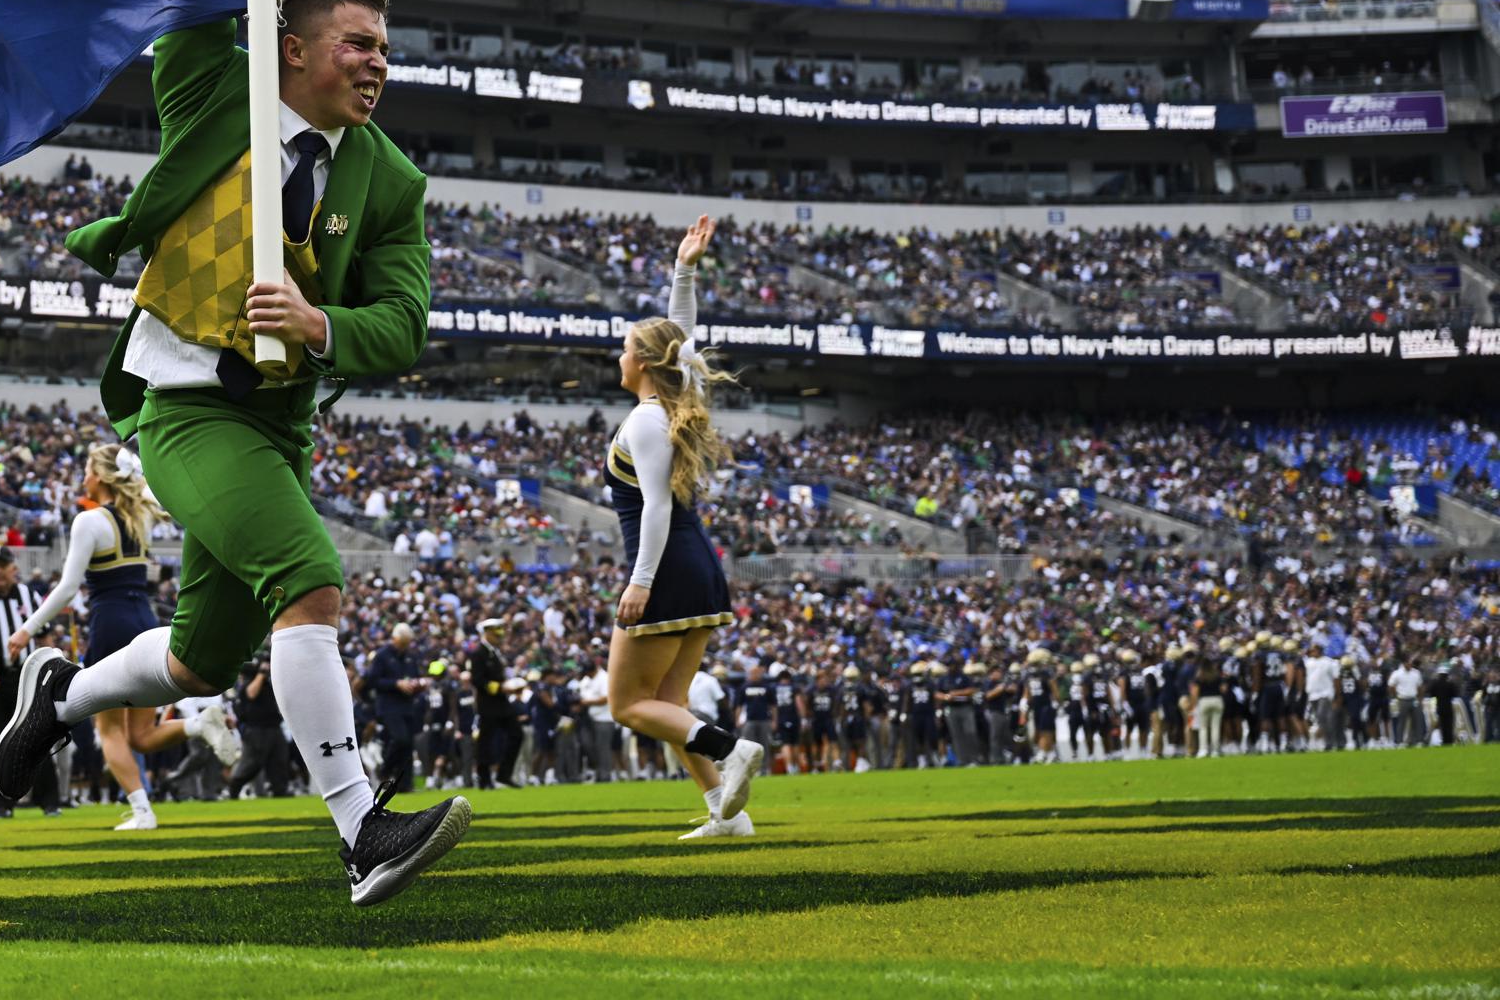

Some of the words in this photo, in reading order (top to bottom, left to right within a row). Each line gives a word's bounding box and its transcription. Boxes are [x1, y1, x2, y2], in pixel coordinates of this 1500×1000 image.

[666, 86, 737, 112] Welcome
[738, 94, 755, 113] to
[757, 95, 783, 116] the
[784, 97, 880, 121] Navy-Notre
[881, 101, 930, 121] Dame
[931, 103, 979, 123] Game
[980, 105, 1065, 127] presented
[1068, 105, 1091, 128] by
[0, 280, 26, 310] by
[455, 309, 475, 330] to
[477, 309, 507, 332] the
[508, 311, 609, 339] Navy-Notre
[793, 324, 815, 350] by
[937, 332, 1006, 355] Welcome
[1008, 335, 1028, 355] to
[1030, 334, 1060, 355] the
[1062, 335, 1161, 359] Navy-Notre
[1163, 335, 1215, 356] Dame
[1217, 335, 1271, 356] Game
[1273, 333, 1367, 358] presented
[1370, 332, 1394, 357] by
